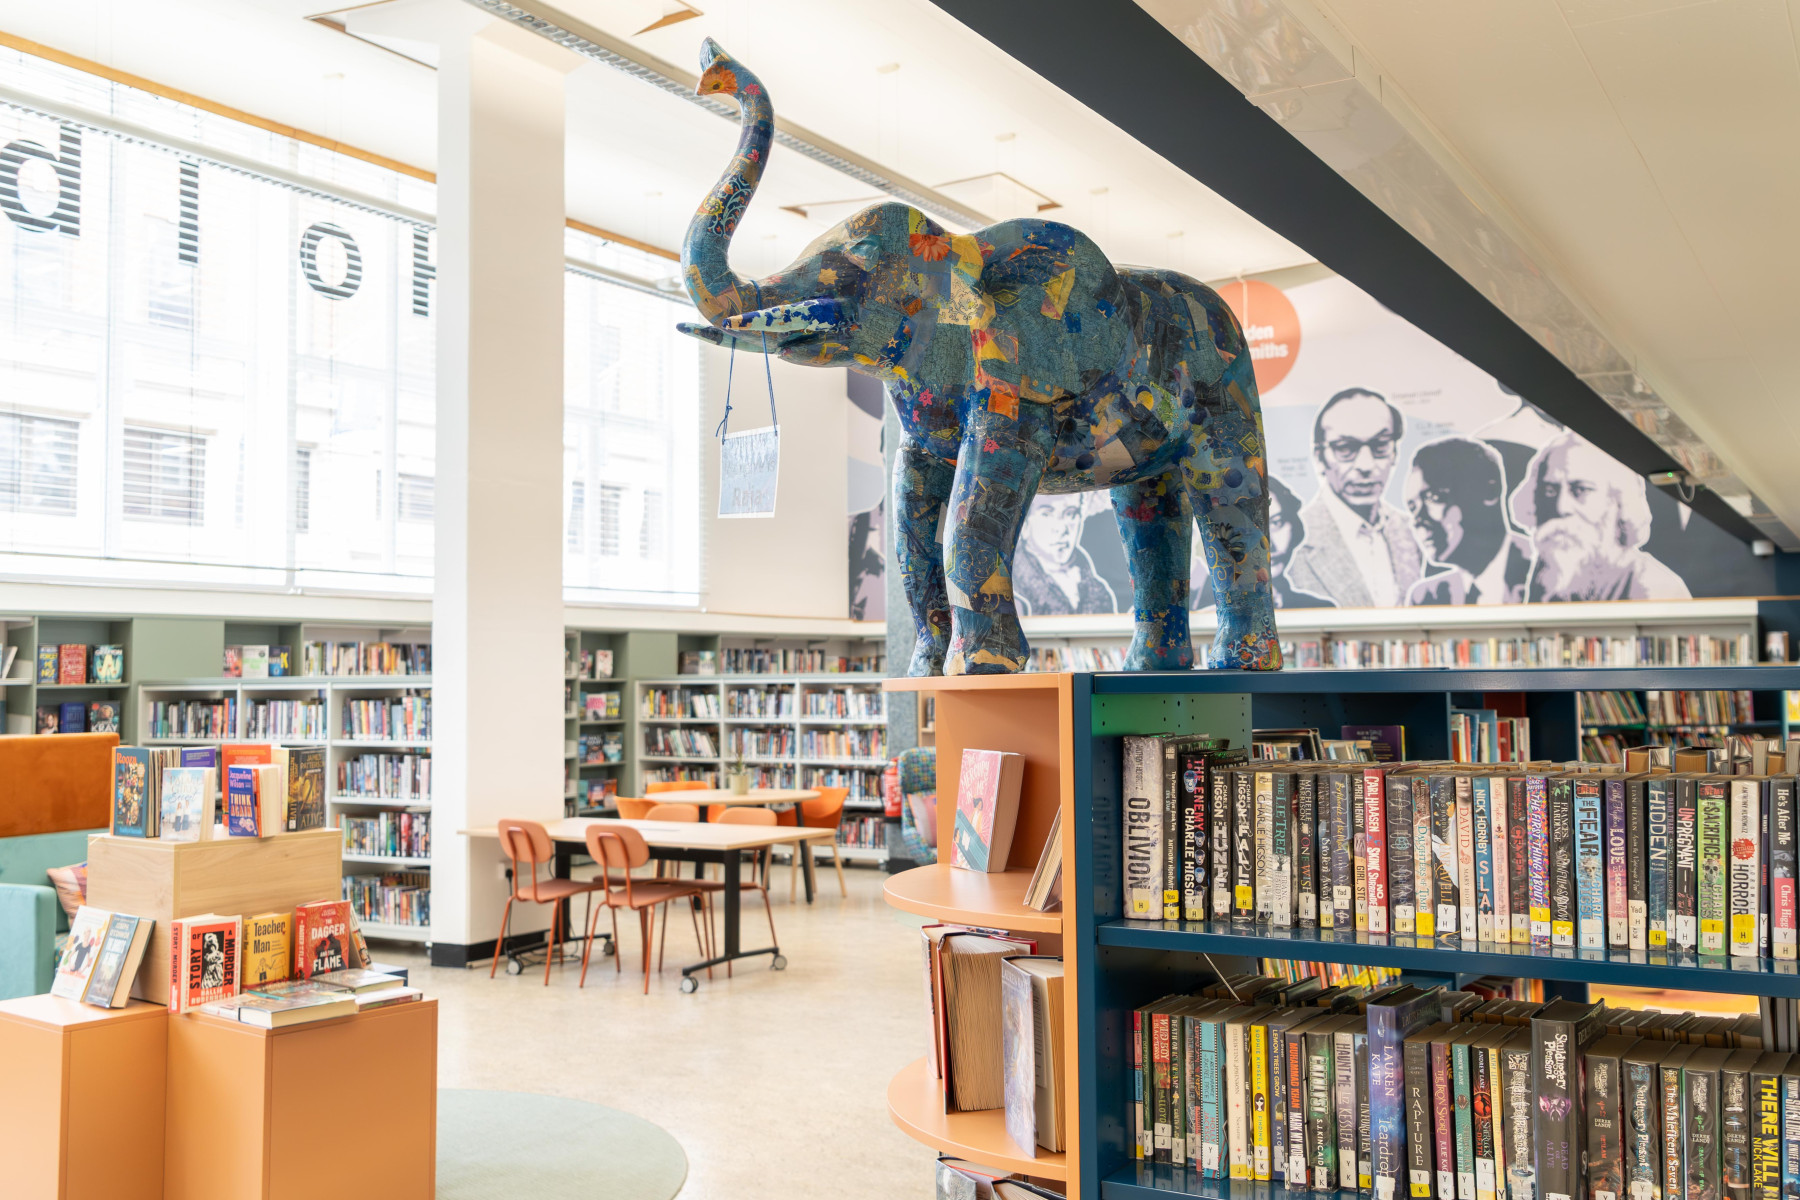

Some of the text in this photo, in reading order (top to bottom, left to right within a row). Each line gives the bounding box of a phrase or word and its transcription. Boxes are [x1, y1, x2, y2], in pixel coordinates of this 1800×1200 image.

[1246, 325, 1274, 341] den
[1250, 343, 1288, 360] miths
[230, 770, 251, 779] Jacqueline
[230, 780, 244, 788] Wilson
[230, 794, 251, 805] THINK
[1194, 759, 1204, 831] THE ENEMY
[1214, 776, 1223, 817] HIGSON
[1238, 775, 1246, 817] HIGSON
[230, 805, 252, 817] AGAIN
[1274, 796, 1287, 855] LIE TREE
[1354, 778, 1363, 828] APRIL HENRY
[1364, 776, 1380, 832] CARL HIAASEN
[1460, 807, 1470, 848] DAVID
[1475, 789, 1488, 855] NICK HORNBY
[1553, 802, 1561, 842] HARDINGE
[1650, 790, 1666, 861] HIDDEN
[1777, 788, 1791, 845] He's After Me
[1128, 797, 1150, 889] OBLIVION
[1185, 808, 1195, 858] CHARLIE
[1257, 795, 1265, 877] CHARLIE HIGSON
[1531, 794, 1543, 904] THE FIRST THING ABOUT
[1579, 808, 1599, 856] FEAR
[1610, 828, 1624, 864] LOVE
[1677, 807, 1695, 871] UNPREGNANT
[1703, 807, 1720, 859] SACRIFICE
[1301, 837, 1311, 893] ONE WISH
[1320, 838, 1331, 901] Stolen Away
[1356, 865, 1365, 885] GIRL,
[1367, 847, 1383, 899] SKINK NO
[1417, 826, 1429, 910] DAUGHTERS TIME
[1733, 864, 1749, 915] HORROR
[1780, 885, 1791, 906] Chris
[254, 920, 285, 937] Teacher
[254, 940, 271, 954] Man
[311, 923, 345, 940] DAGGER
[190, 948, 201, 989] STORY
[224, 939, 235, 986] MURDER
[313, 955, 342, 972] FLAME
[1160, 1042, 1169, 1060] BOY
[1371, 1053, 1381, 1086] KATE
[1384, 1045, 1395, 1097] LAUREN
[1544, 1041, 1556, 1079] Pleasant
[1553, 1034, 1568, 1089] Skulduggery
[1289, 1042, 1303, 1143] MUHAMMAD KHAN MARK MY
[1309, 1055, 1328, 1114] CATALYST
[1336, 1043, 1352, 1143] HAUNT ME KESSLER
[1159, 1099, 1167, 1123] LLOYD
[1412, 1087, 1424, 1166] RAPTURE
[1434, 1070, 1448, 1158] THE IRON SWORD JULIE
[1634, 1085, 1649, 1167] Skulduggery Pleasant
[1761, 1078, 1779, 1182] THERE WILL
[1785, 1079, 1800, 1175] YOUNG SHERLOCK KNIFE EDGE
[1546, 1140, 1554, 1168] ALIVE
[1666, 1087, 1679, 1190] The Maleficent Seven
[1753, 1137, 1763, 1188] NICK LAKE
